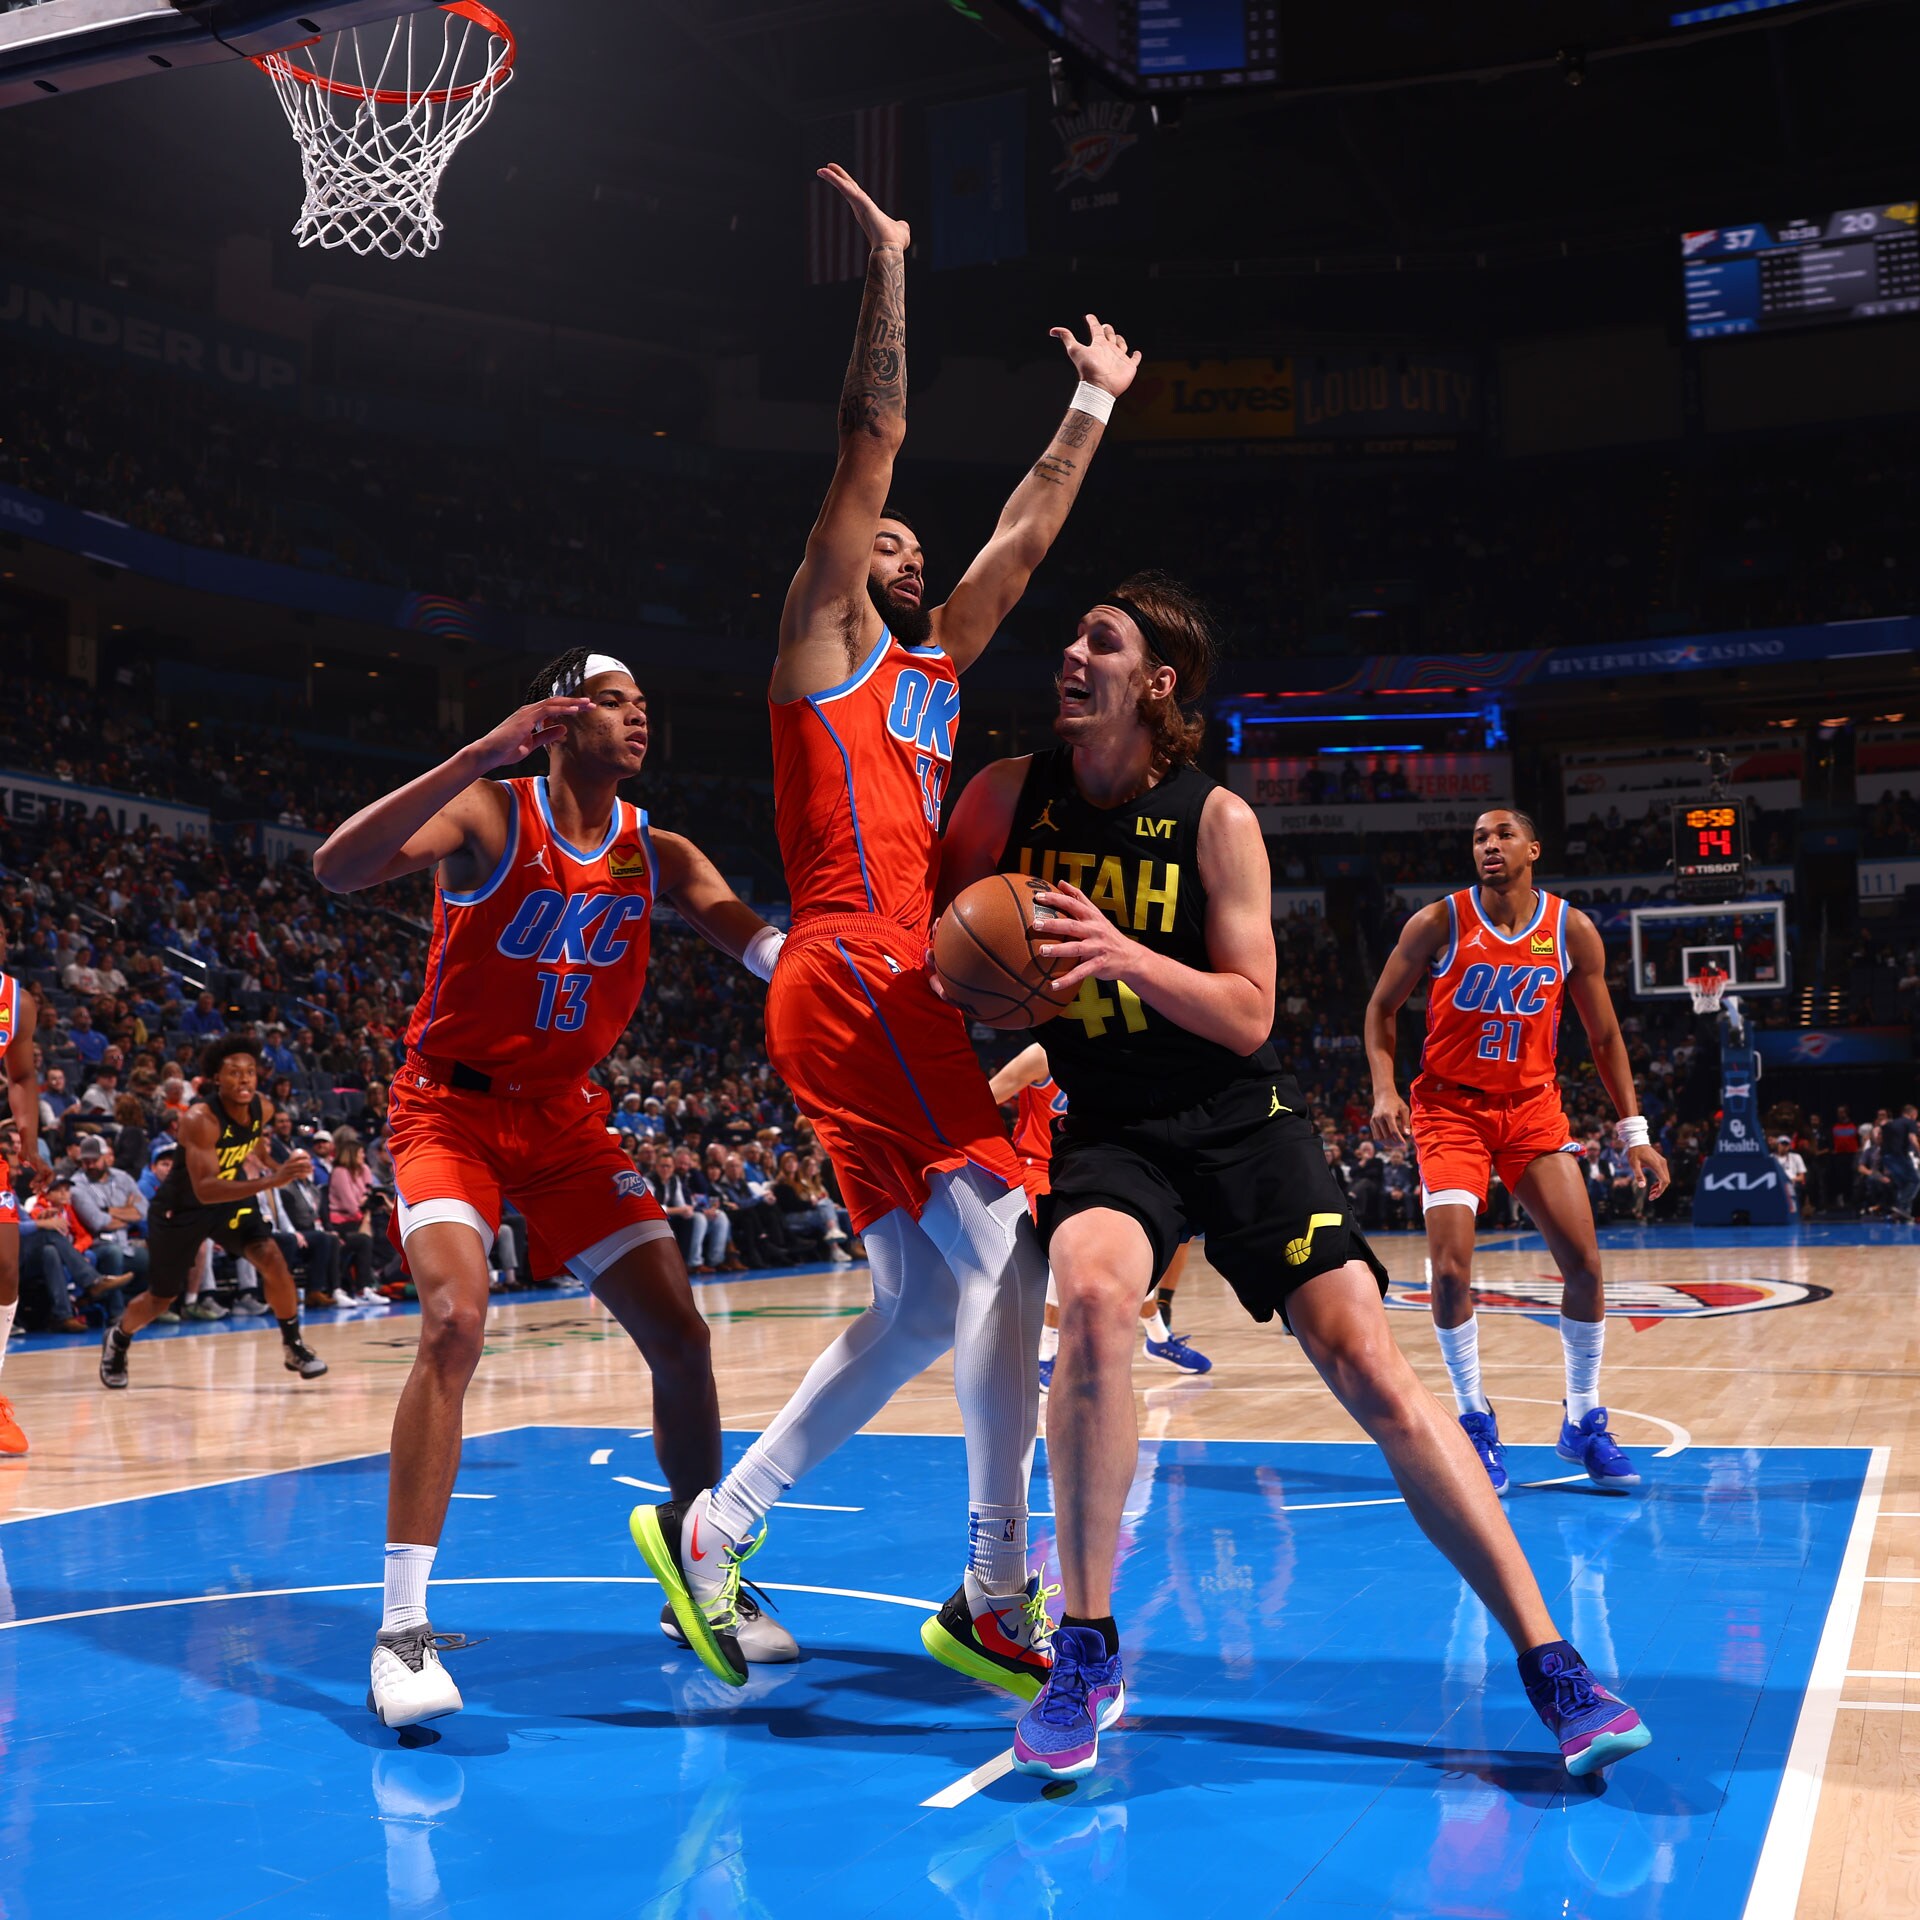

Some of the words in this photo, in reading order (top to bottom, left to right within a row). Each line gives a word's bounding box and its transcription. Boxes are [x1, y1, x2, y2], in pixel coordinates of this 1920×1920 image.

[1050, 101, 1135, 142] THUNDER
[1723, 229, 1756, 250] 37
[1840, 212, 1878, 234] 20
[216, 343, 297, 390] UP
[1302, 364, 1391, 426] LOUD
[1399, 364, 1474, 420] CITY
[1134, 815, 1178, 839] LVT
[1697, 828, 1733, 857] 14
[496, 888, 646, 967] OKC
[535, 971, 593, 1032] 13
[1452, 963, 1558, 1016] OKC
[1477, 1019, 1523, 1063] 21
[1719, 1138, 1760, 1153] Health
[1704, 1170, 1777, 1191] KIA
